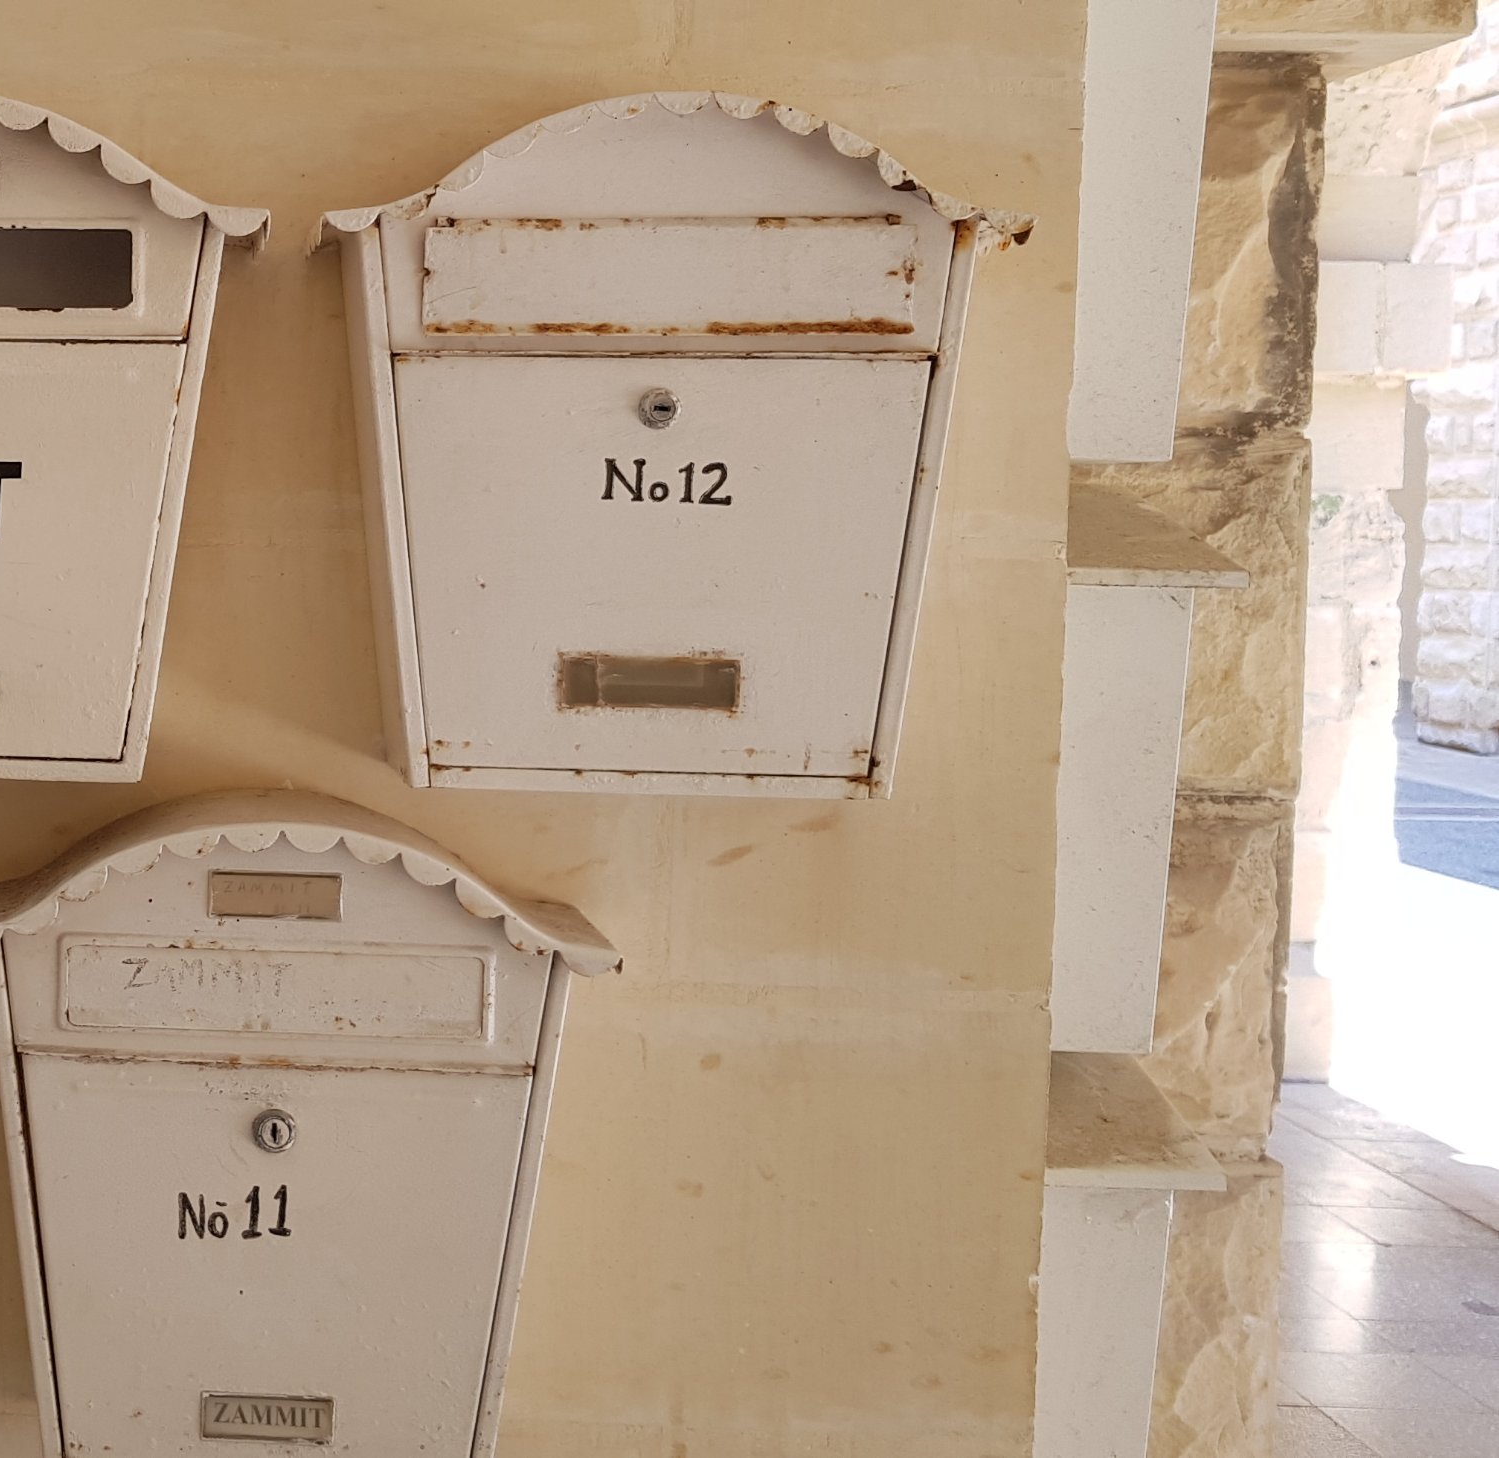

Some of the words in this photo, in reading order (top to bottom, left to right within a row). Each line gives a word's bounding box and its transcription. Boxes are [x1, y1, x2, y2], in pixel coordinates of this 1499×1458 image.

[222, 879, 313, 896] ZAMMIT
[122, 957, 292, 998] ZAMMIT
[240, 1184, 293, 1240] 11
[212, 1401, 326, 1429] ZAMMIT
